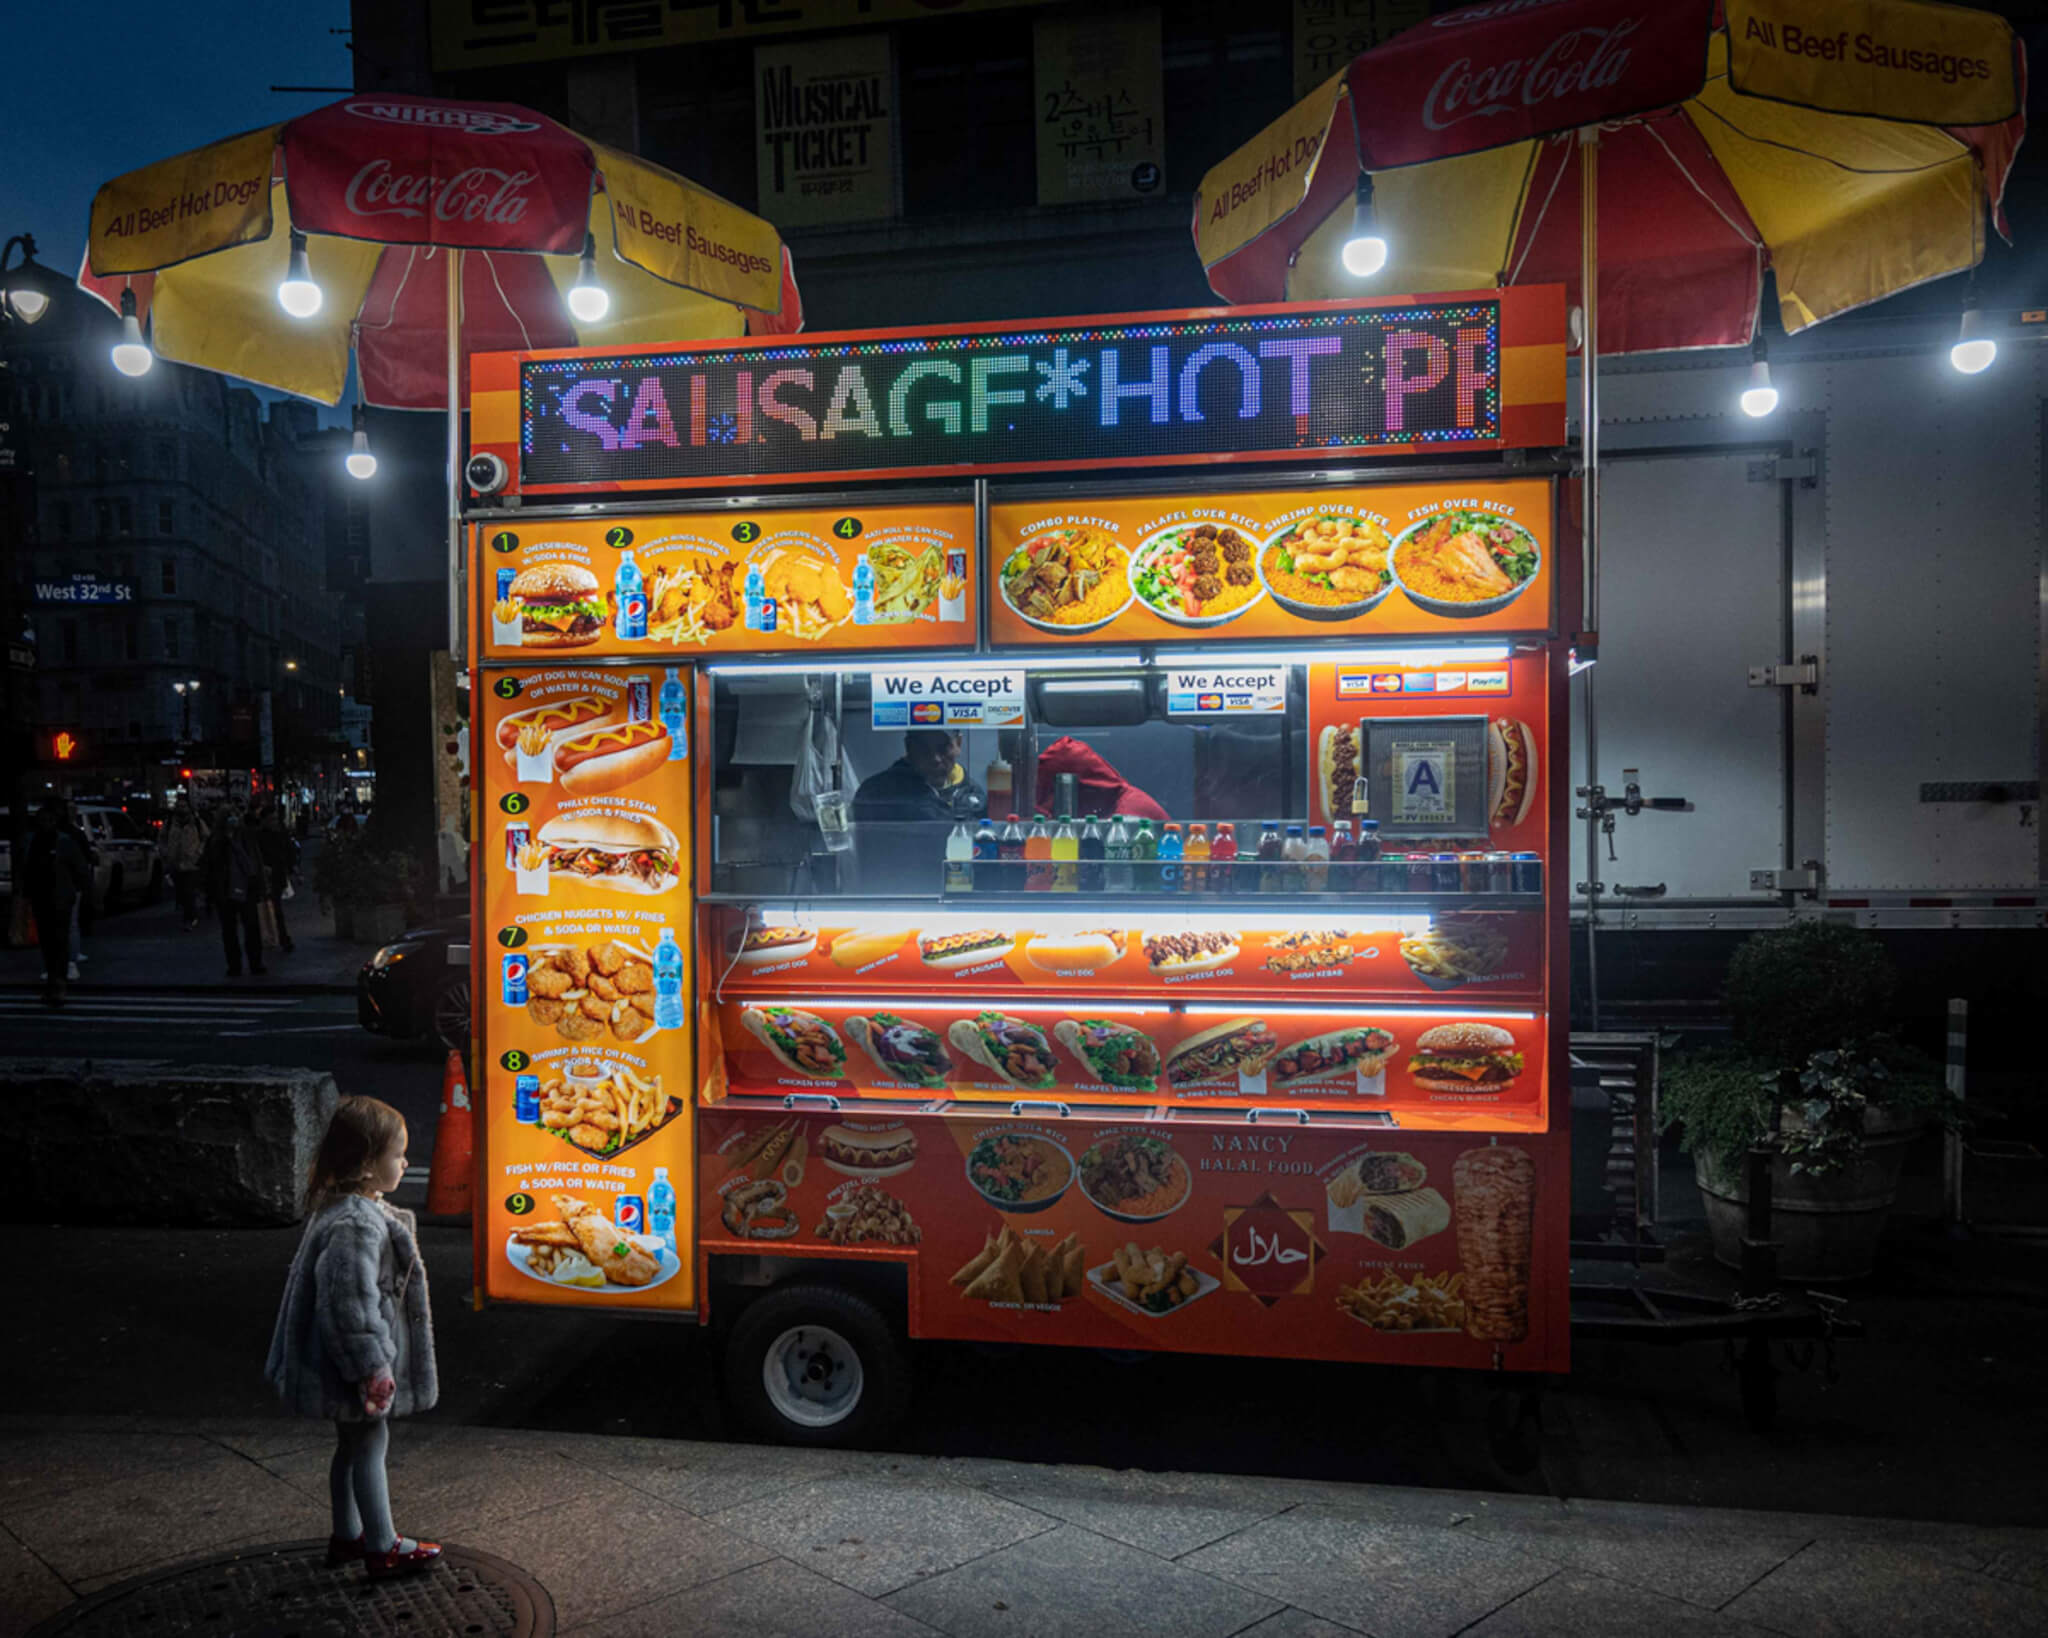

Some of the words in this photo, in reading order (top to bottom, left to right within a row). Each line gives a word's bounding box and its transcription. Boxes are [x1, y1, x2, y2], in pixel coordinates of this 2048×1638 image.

[1745, 17, 1779, 47] All
[1783, 26, 1846, 60] Beef
[1853, 34, 1990, 83] Sausages
[1422, 15, 1649, 131] Coca-Cola
[764, 65, 887, 128] MUSICAL
[765, 125, 870, 192] TICKET
[345, 159, 539, 223] Coca-Cola
[1211, 192, 1229, 225] All
[1232, 166, 1263, 210] Beef
[1265, 149, 1291, 183] Hot
[104, 214, 134, 239] All
[136, 200, 176, 236] Beef
[180, 188, 212, 222] Hot
[214, 176, 259, 212] Dogs
[640, 211, 683, 248] Beef
[686, 227, 772, 274] Sausages
[1264, 507, 1314, 532] SHRIMP
[1320, 503, 1353, 515] OVER
[1358, 508, 1390, 527] RICE
[1408, 502, 1438, 520] FISH
[1444, 498, 1478, 510] OVER
[1483, 500, 1515, 516] RICE
[1020, 516, 1063, 536] COMBO
[1068, 515, 1120, 533] PLATTER
[1137, 510, 1188, 536] FALAFEL
[1192, 508, 1226, 519] OVER
[1230, 512, 1260, 532] RICE
[35, 583, 77, 601] West
[80, 582, 112, 601] 32nd
[114, 583, 132, 601] St
[545, 671, 565, 680] DOG
[1178, 674, 1207, 689] We
[1213, 674, 1276, 690] Accept
[1472, 677, 1503, 686] PayPal
[530, 687, 544, 699] OR
[546, 683, 579, 694] WATER
[582, 684, 590, 692] &
[885, 676, 922, 694] We
[930, 676, 1013, 697] Accept
[952, 708, 978, 718] VISA
[1408, 760, 1440, 794] A
[558, 798, 589, 810] PHILLY
[591, 797, 627, 807] CHEESE
[1161, 864, 1176, 881] G
[515, 910, 562, 924] CHICKEN
[564, 908, 613, 921] NUGGETS
[634, 910, 665, 923] FRIES
[544, 926, 553, 936] &
[555, 924, 583, 935] SODA
[586, 924, 601, 935] OR
[604, 924, 640, 936] WATER
[815, 1079, 837, 1088] GYRO
[1212, 1135, 1293, 1152] NANCY
[505, 1163, 532, 1176] FISH
[582, 1162, 599, 1174] OR
[602, 1164, 636, 1178] FRIES
[1200, 1157, 1260, 1172] HALAL
[1269, 1160, 1314, 1175] FOOD
[520, 1179, 529, 1189] &
[532, 1178, 564, 1190] SODA
[567, 1178, 582, 1189] OR
[585, 1178, 625, 1192] WATER
[1233, 1226, 1308, 1266] حلال
